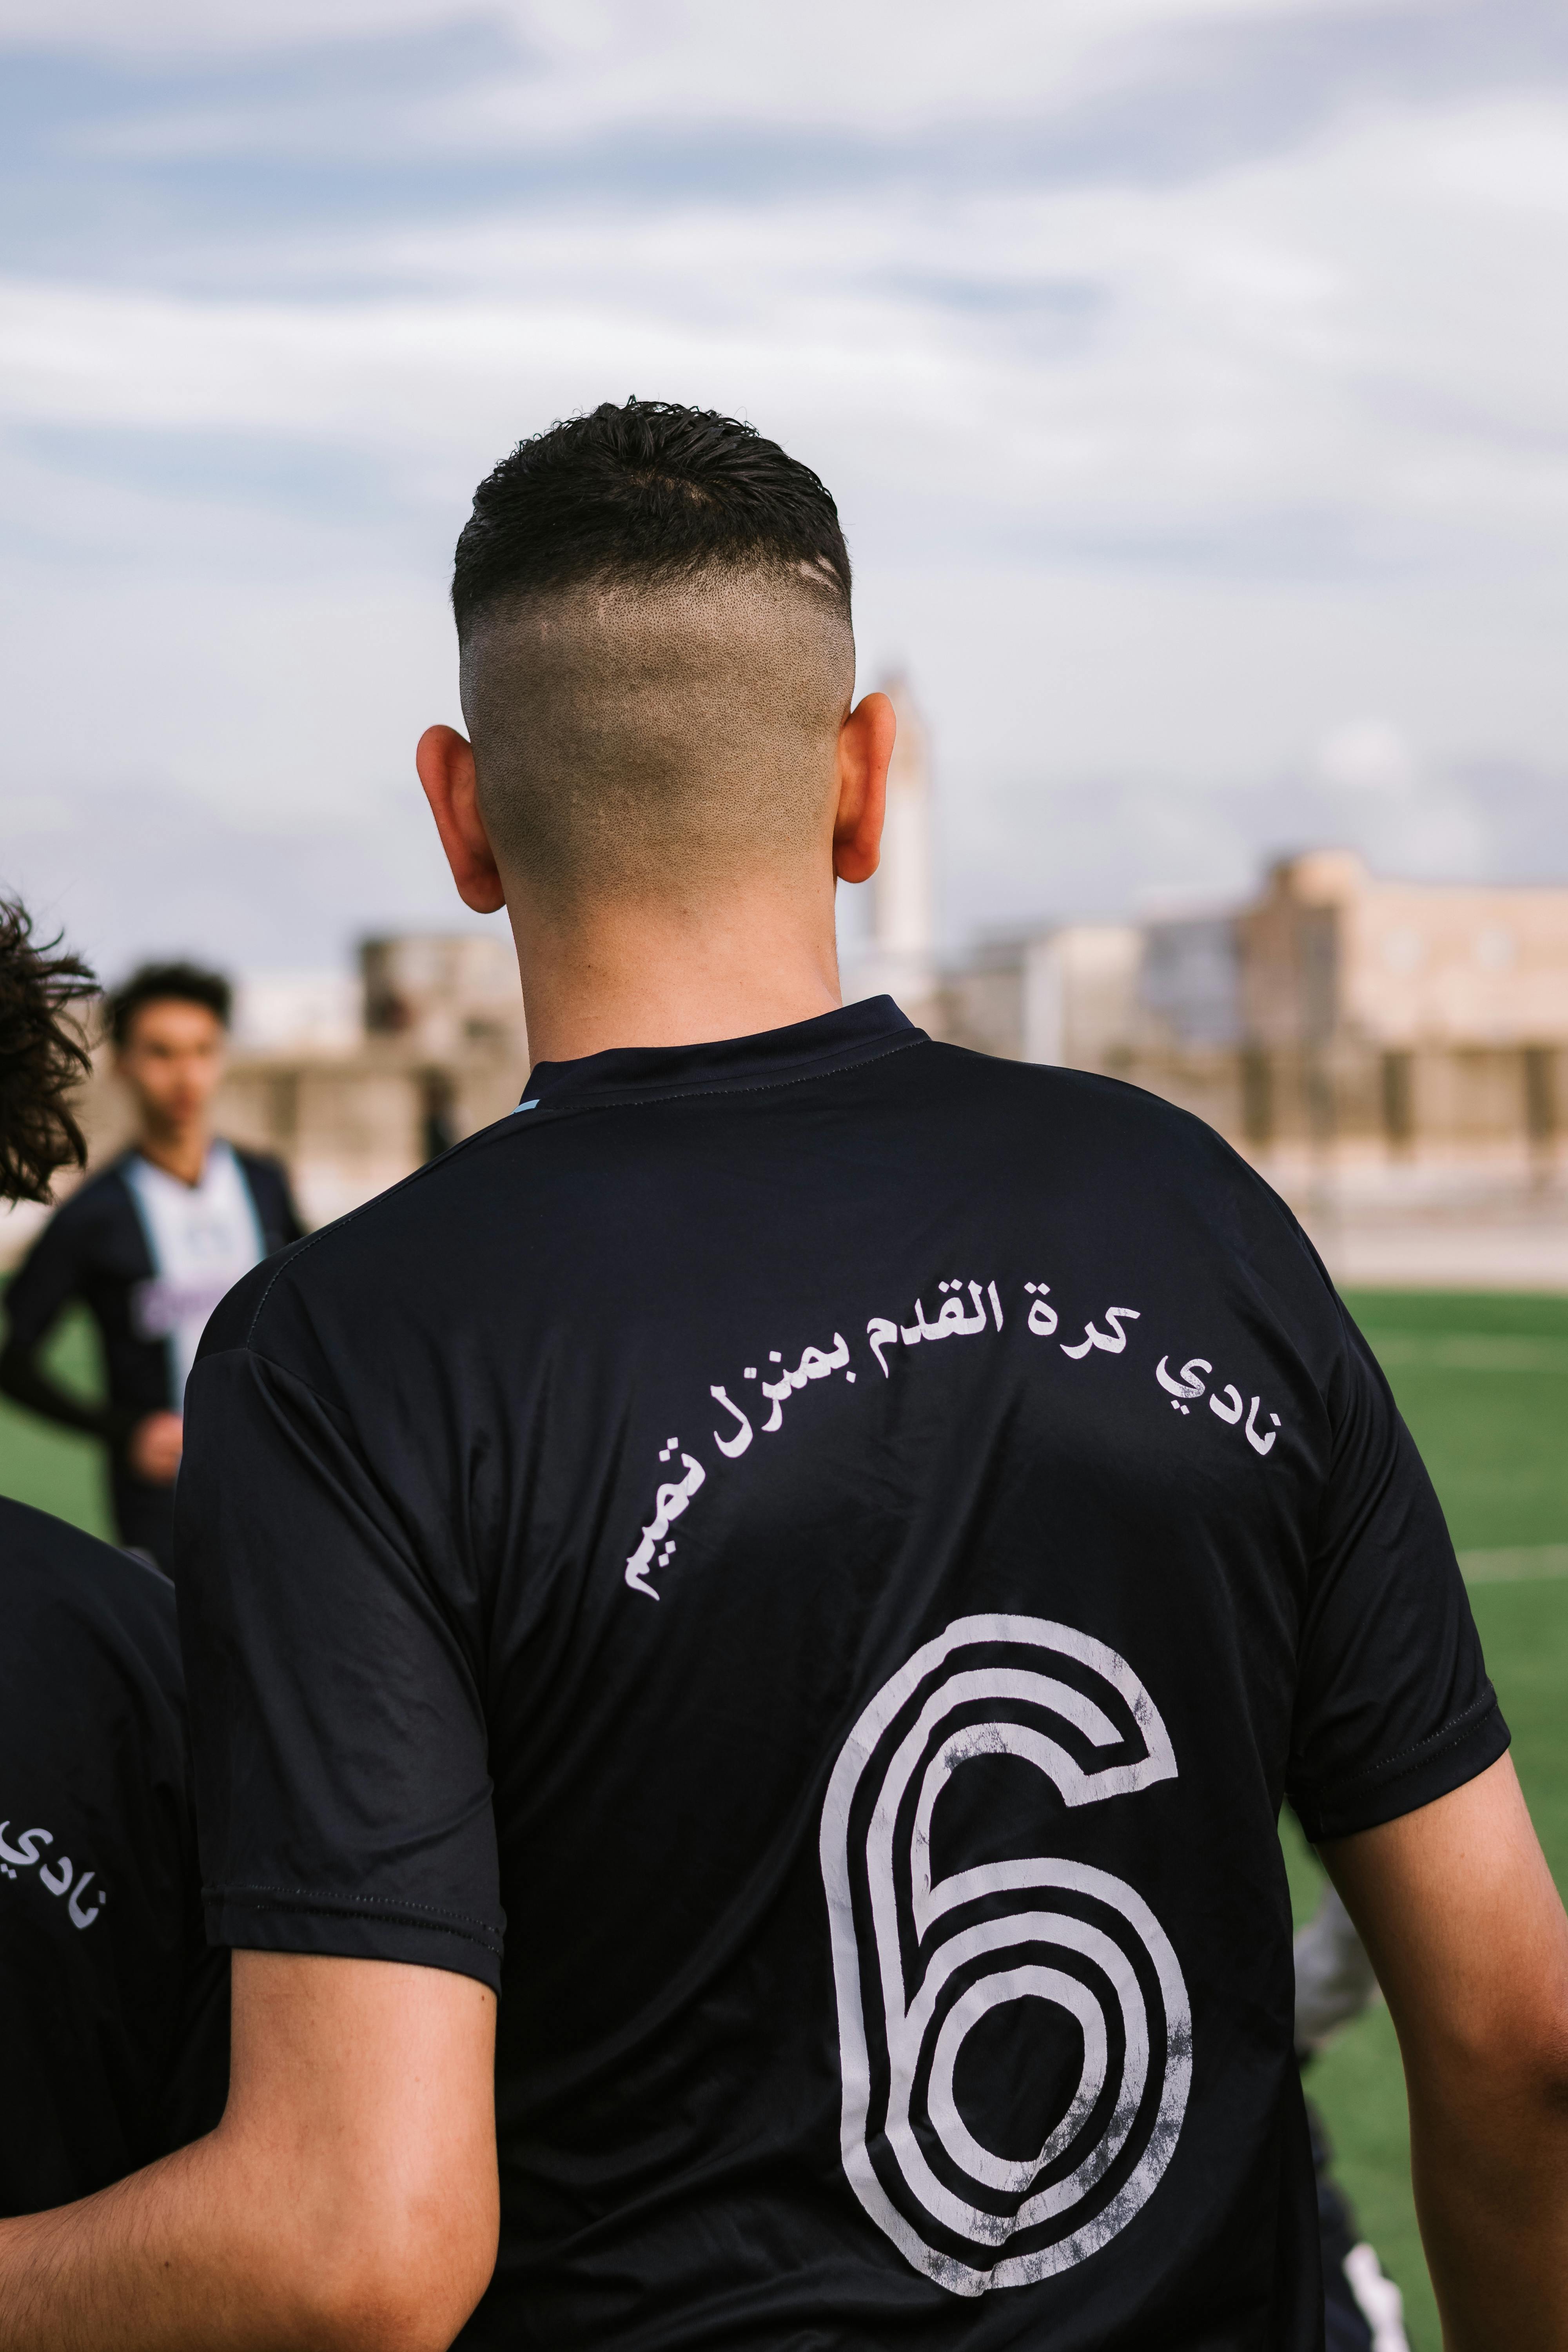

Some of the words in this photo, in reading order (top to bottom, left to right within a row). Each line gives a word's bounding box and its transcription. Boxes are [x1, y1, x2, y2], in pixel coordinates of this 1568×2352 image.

[866, 1279, 1004, 1379] القدم
[1024, 1281, 1141, 1359] كرة
[710, 1332, 857, 1459] بمنزل
[1156, 1355, 1281, 1455] نادي
[624, 1437, 706, 1601] تميم
[0, 1820, 106, 1929] نادي
[819, 1613, 1193, 2297] 6
